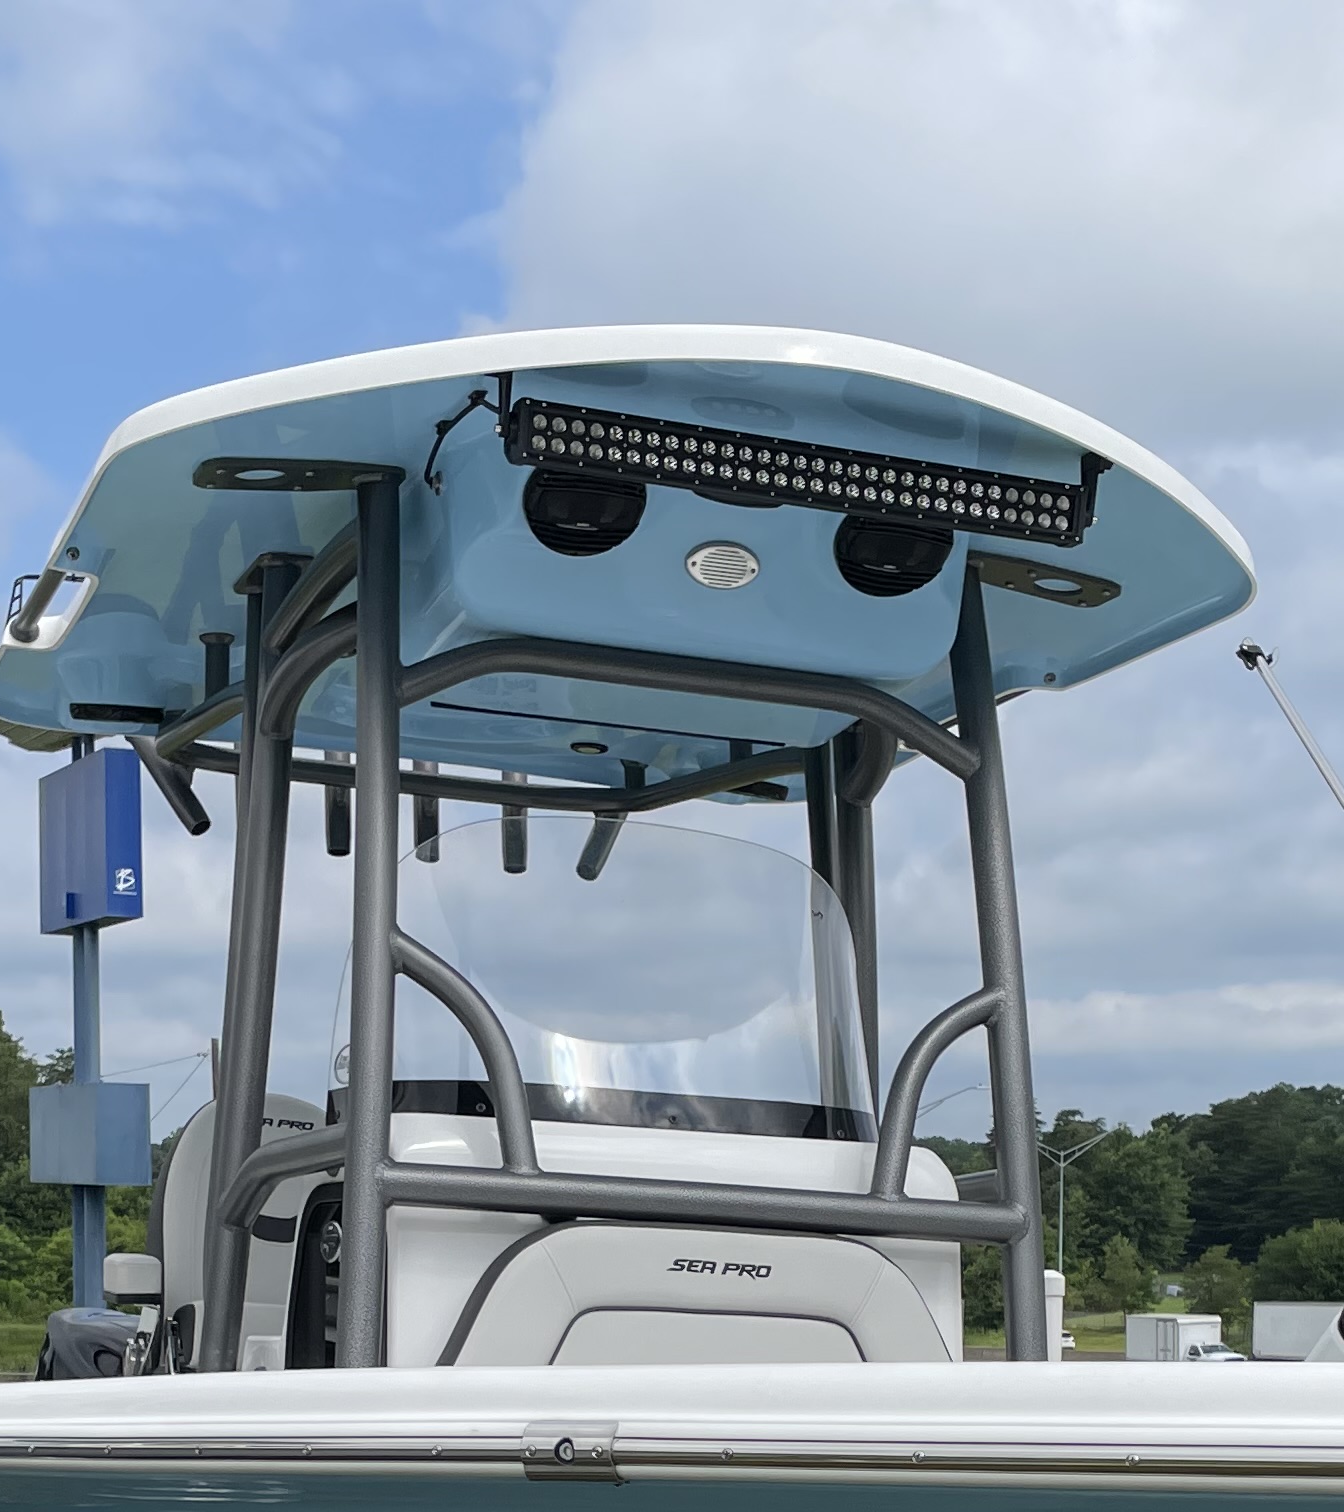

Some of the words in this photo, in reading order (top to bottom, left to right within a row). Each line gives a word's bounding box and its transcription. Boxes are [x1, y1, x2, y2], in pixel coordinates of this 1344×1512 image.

[277, 1119, 314, 1131] PRO
[666, 1259, 717, 1274] SEA
[721, 1262, 772, 1280] PRO
